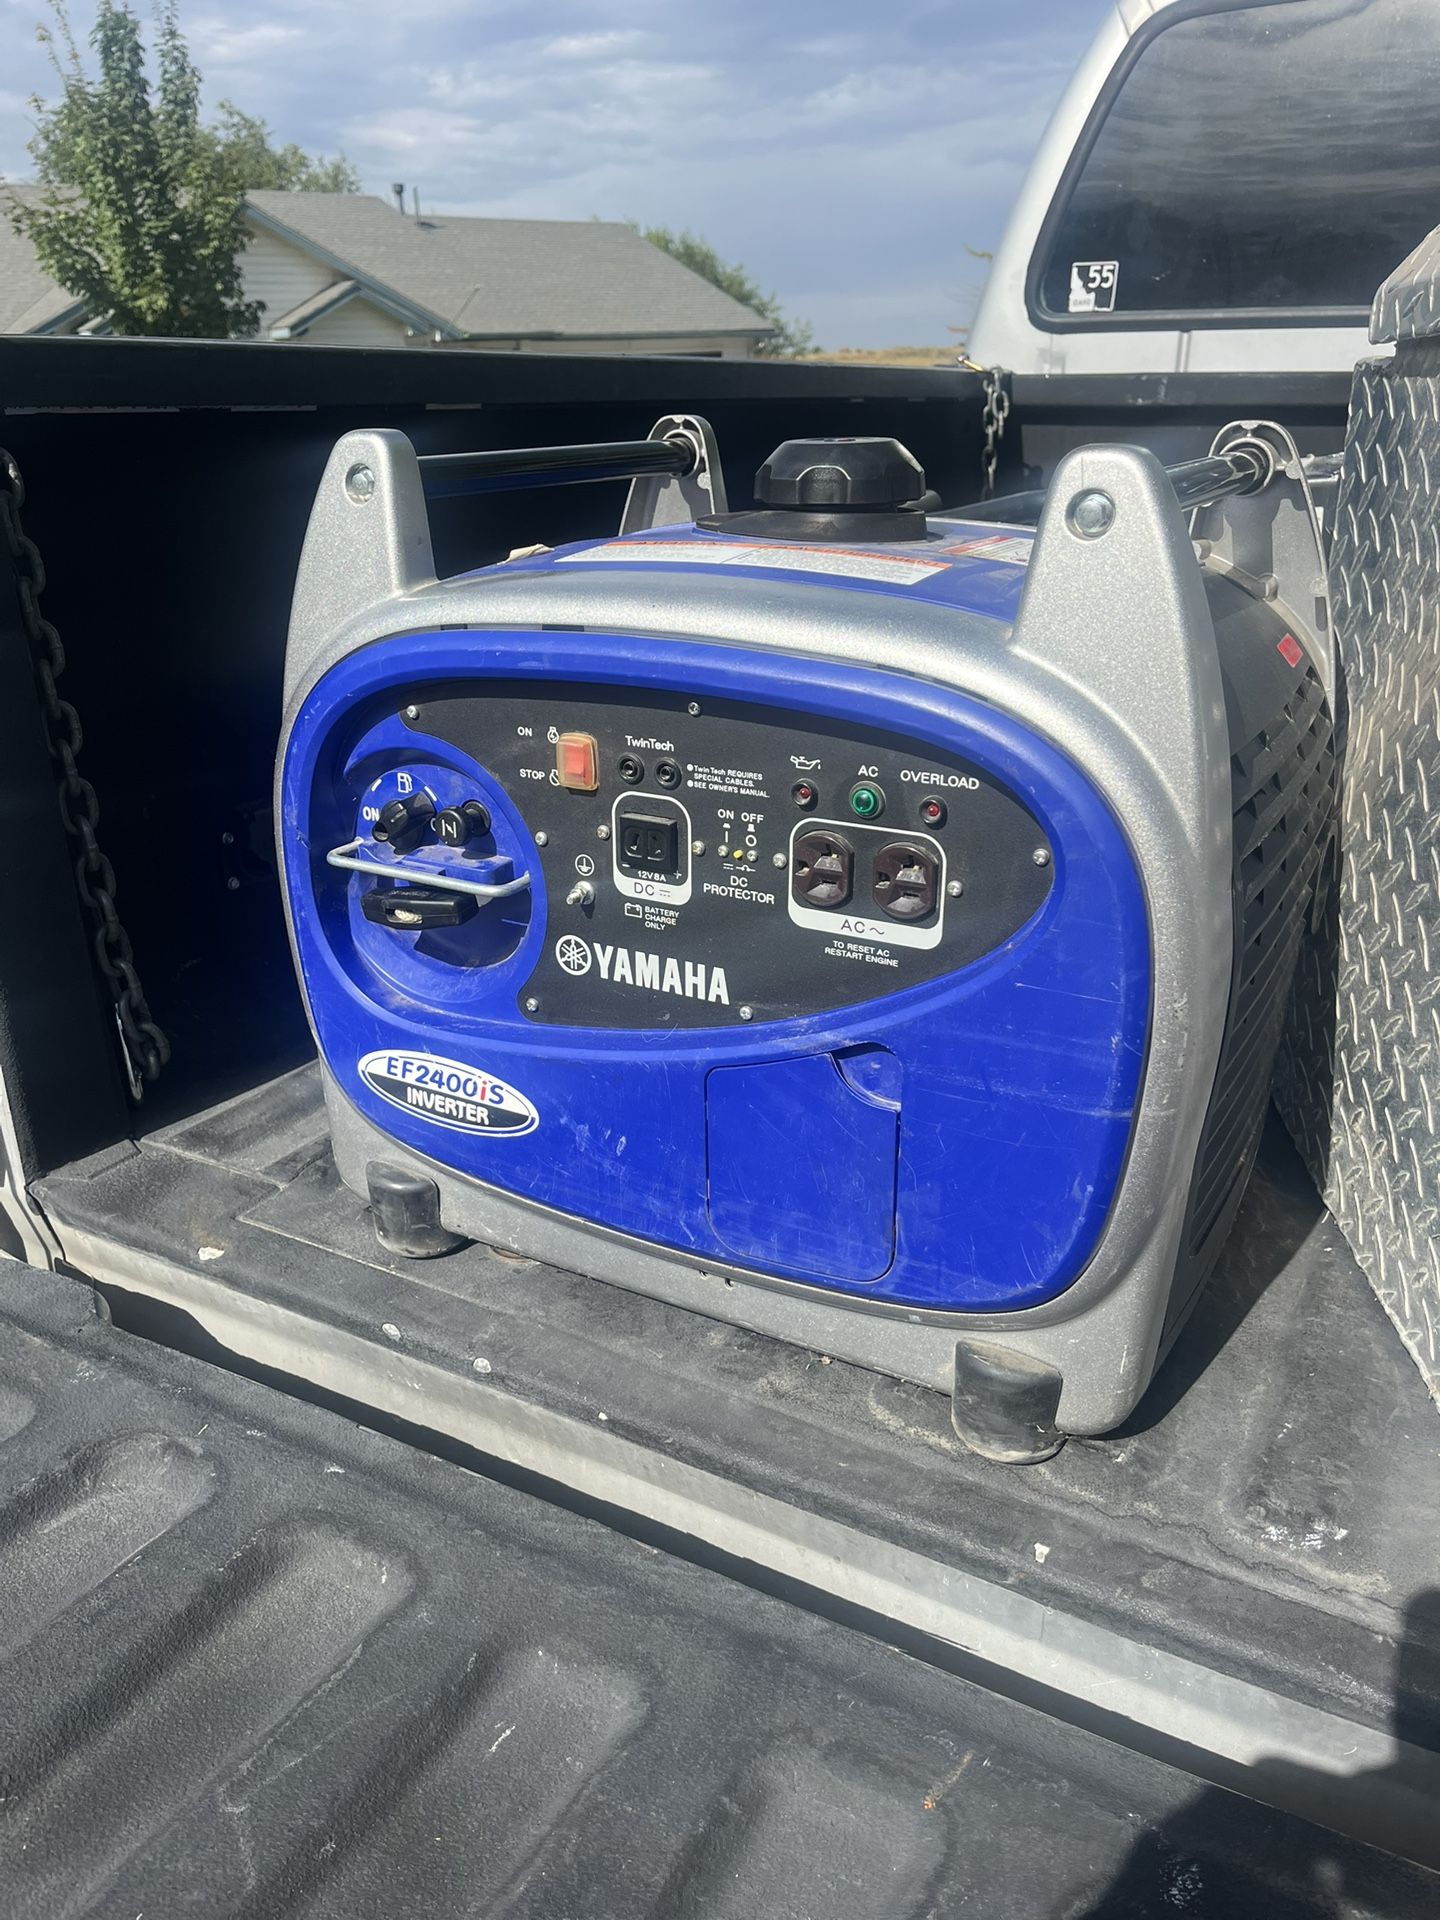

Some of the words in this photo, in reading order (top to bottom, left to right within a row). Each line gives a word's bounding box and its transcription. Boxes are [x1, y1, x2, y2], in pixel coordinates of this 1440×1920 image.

[1087, 264, 1115, 289] 55
[517, 726, 533, 737] ON
[625, 735, 674, 752] TwinTech
[519, 768, 546, 780] STOP
[694, 764, 710, 773] Twin
[710, 767, 726, 776] Tech
[727, 769, 763, 781] REQUIRES
[857, 764, 880, 778] AC
[694, 772, 723, 783] SPECIAL
[725, 777, 755, 788] CABLES.
[899, 769, 980, 790] OVERLOAD
[694, 781, 707, 789] SEE
[708, 783, 739, 794] OWNER'S
[740, 787, 770, 798] MANUAL.
[362, 806, 380, 821] ON
[717, 808, 735, 820] ON
[740, 812, 765, 824] OFF
[634, 882, 655, 896] DC
[729, 875, 748, 888] DC
[703, 883, 775, 904] PROTECTOR
[644, 906, 680, 918] BATTERY
[644, 913, 677, 926] CHARGE
[644, 921, 666, 930] ONLY
[840, 919, 866, 934] AC
[833, 940, 845, 949] TO
[847, 943, 875, 954] RESET
[876, 949, 890, 957] AC
[824, 947, 863, 960] RESTART
[865, 954, 899, 967] ENGINE
[593, 942, 730, 1005] YAMAHA
[386, 1056, 506, 1105] EF2400iS
[406, 1086, 489, 1126] INVERTER
